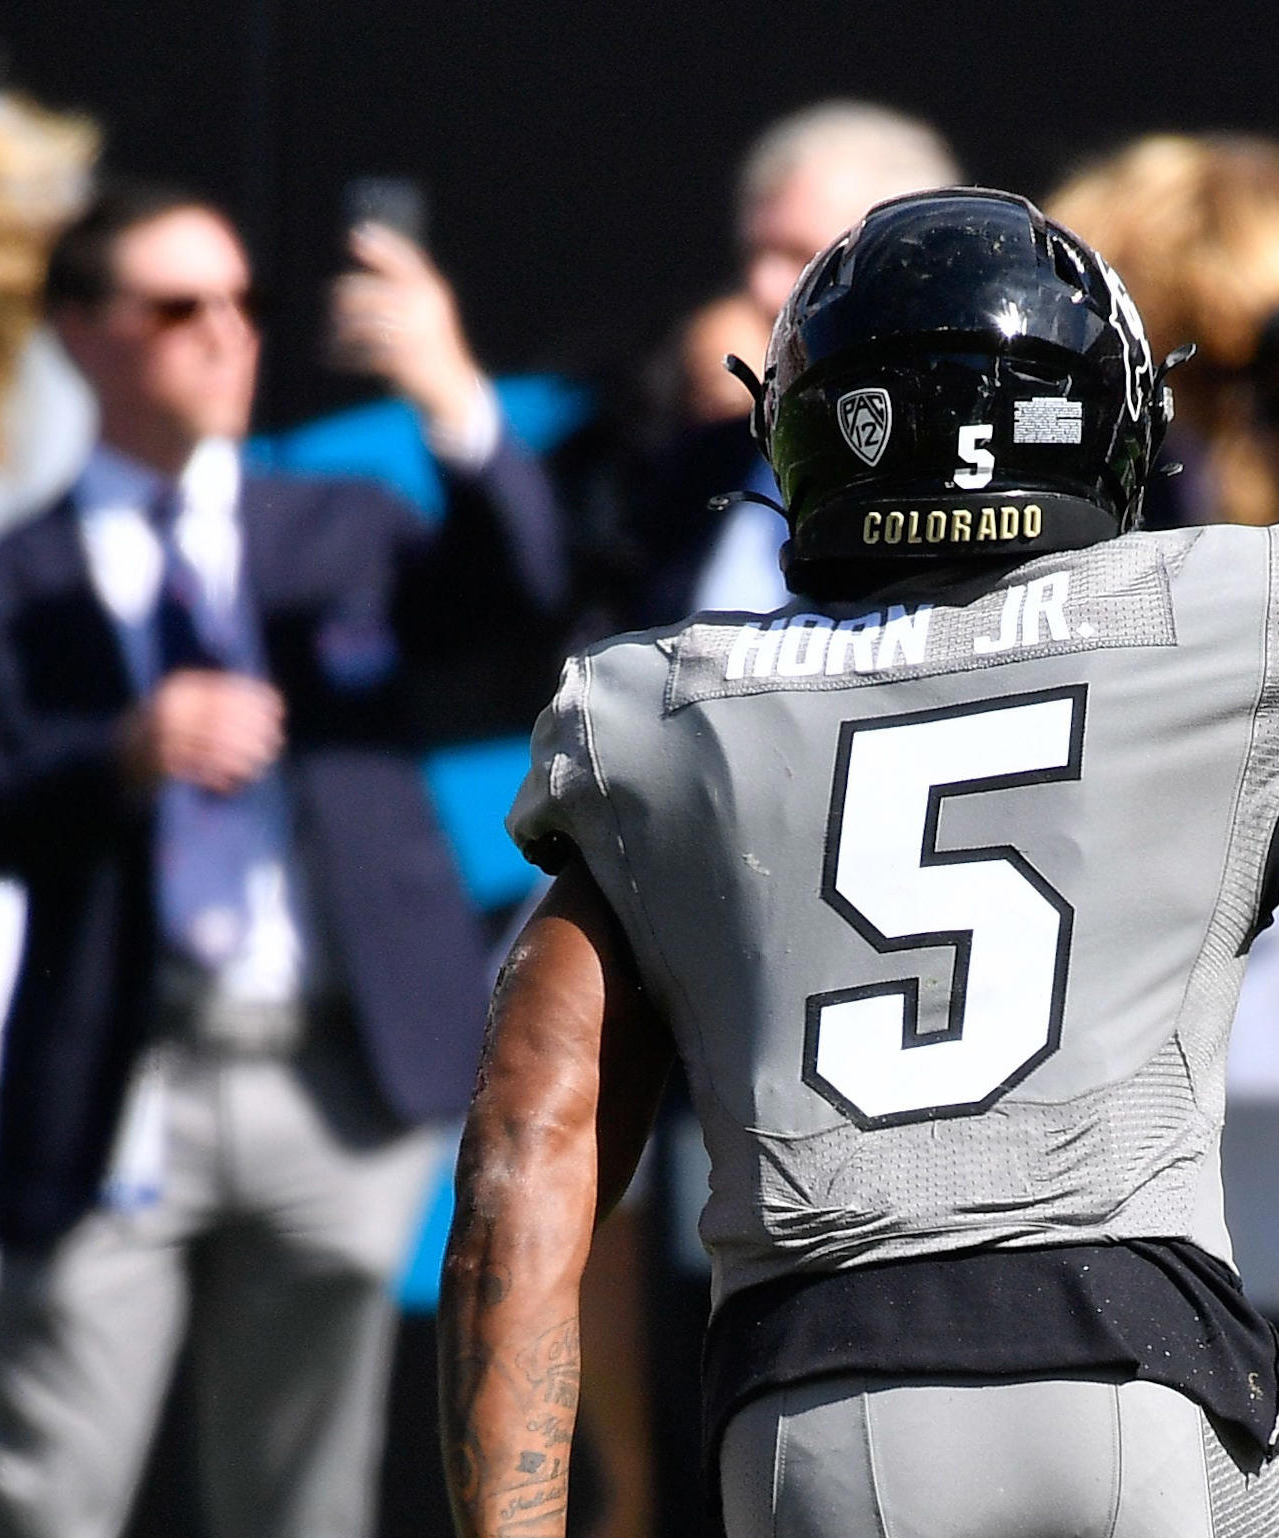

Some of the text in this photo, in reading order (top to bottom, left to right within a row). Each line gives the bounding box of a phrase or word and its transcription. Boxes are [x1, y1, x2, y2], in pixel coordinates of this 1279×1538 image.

[842, 393, 884, 437] PAC
[855, 421, 880, 448] 12
[953, 424, 996, 490] 5
[863, 504, 1042, 544] COLORADO
[725, 571, 1096, 680] HORN JR.
[802, 683, 1089, 1132] 5
